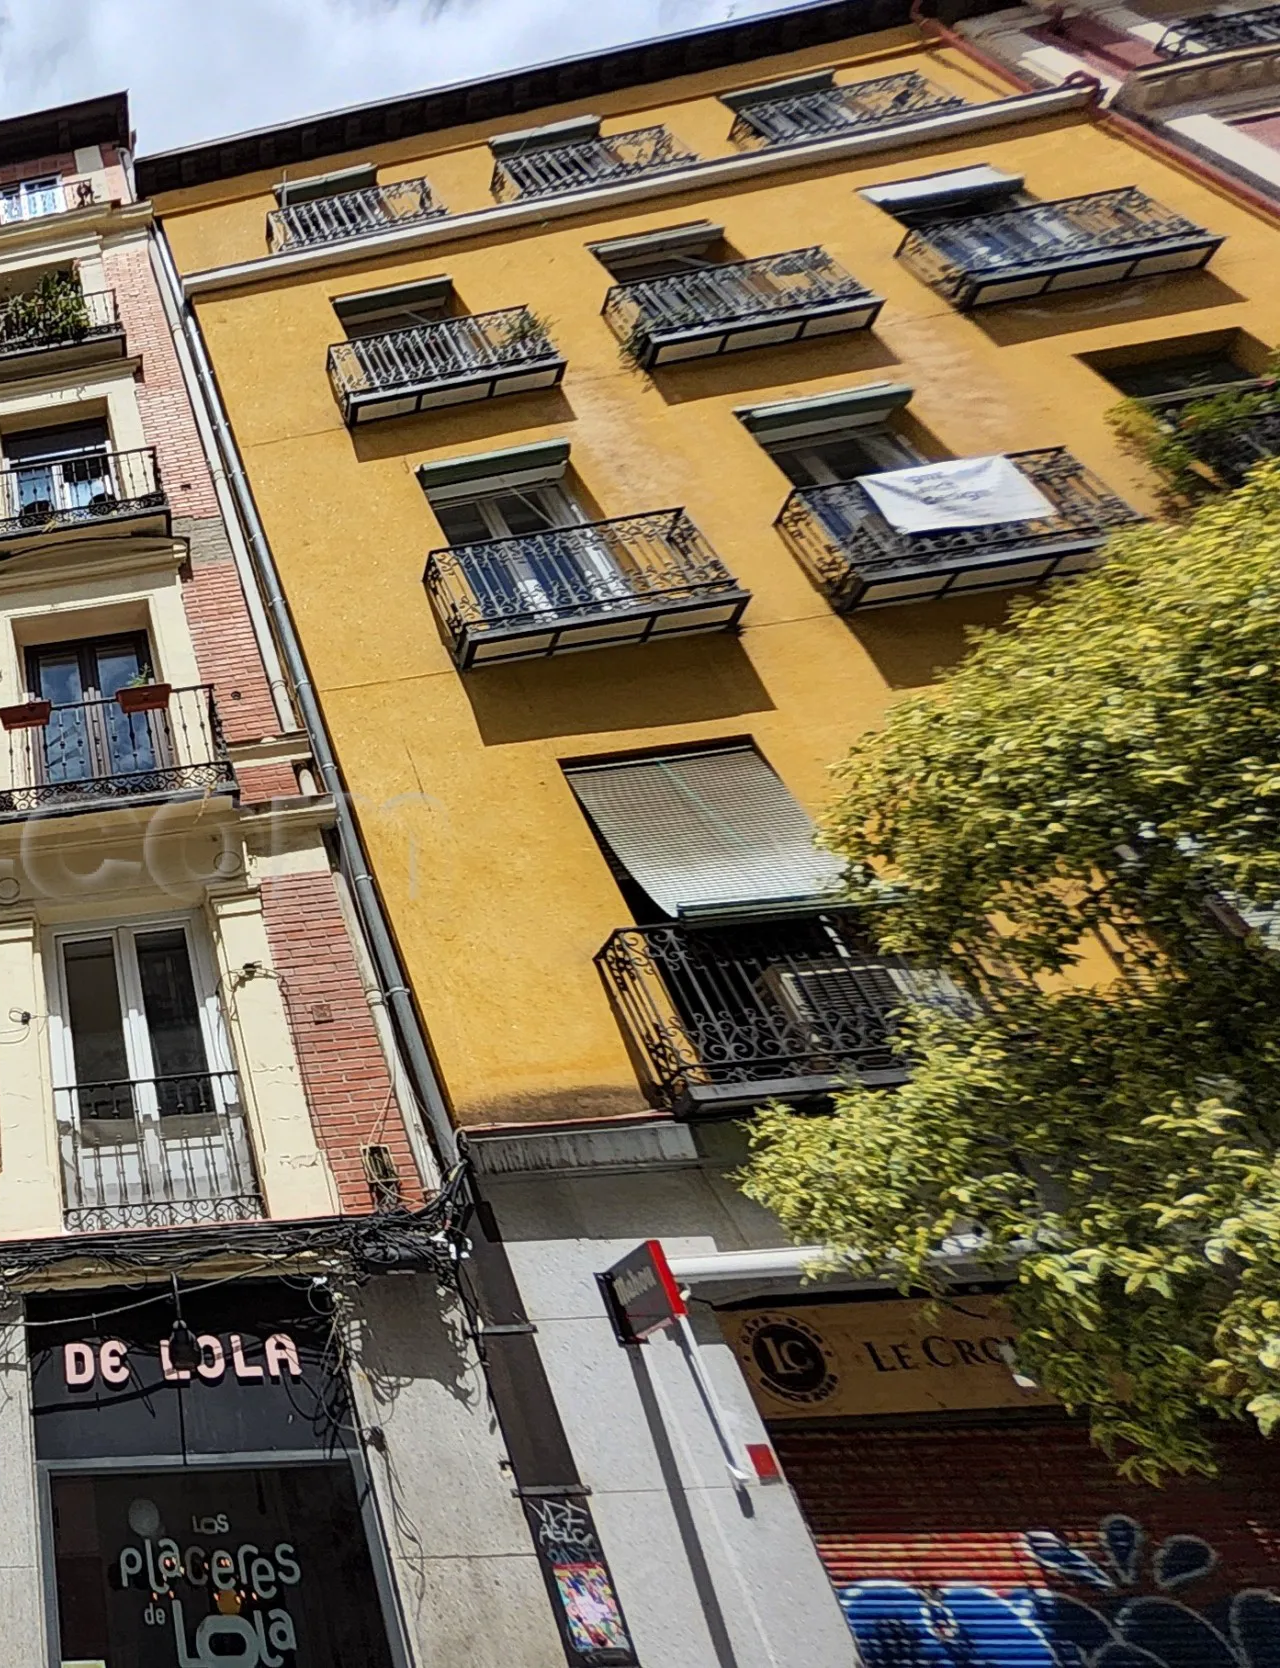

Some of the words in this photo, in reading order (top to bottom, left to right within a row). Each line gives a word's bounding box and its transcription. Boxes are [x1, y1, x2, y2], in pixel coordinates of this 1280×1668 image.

[65, 1340, 130, 1384] DE
[160, 1333, 303, 1381] LOLA
[761, 1337, 815, 1375] LC
[862, 1341, 920, 1372] LE
[119, 1538, 301, 1599] placeres
[144, 1602, 166, 1625] de
